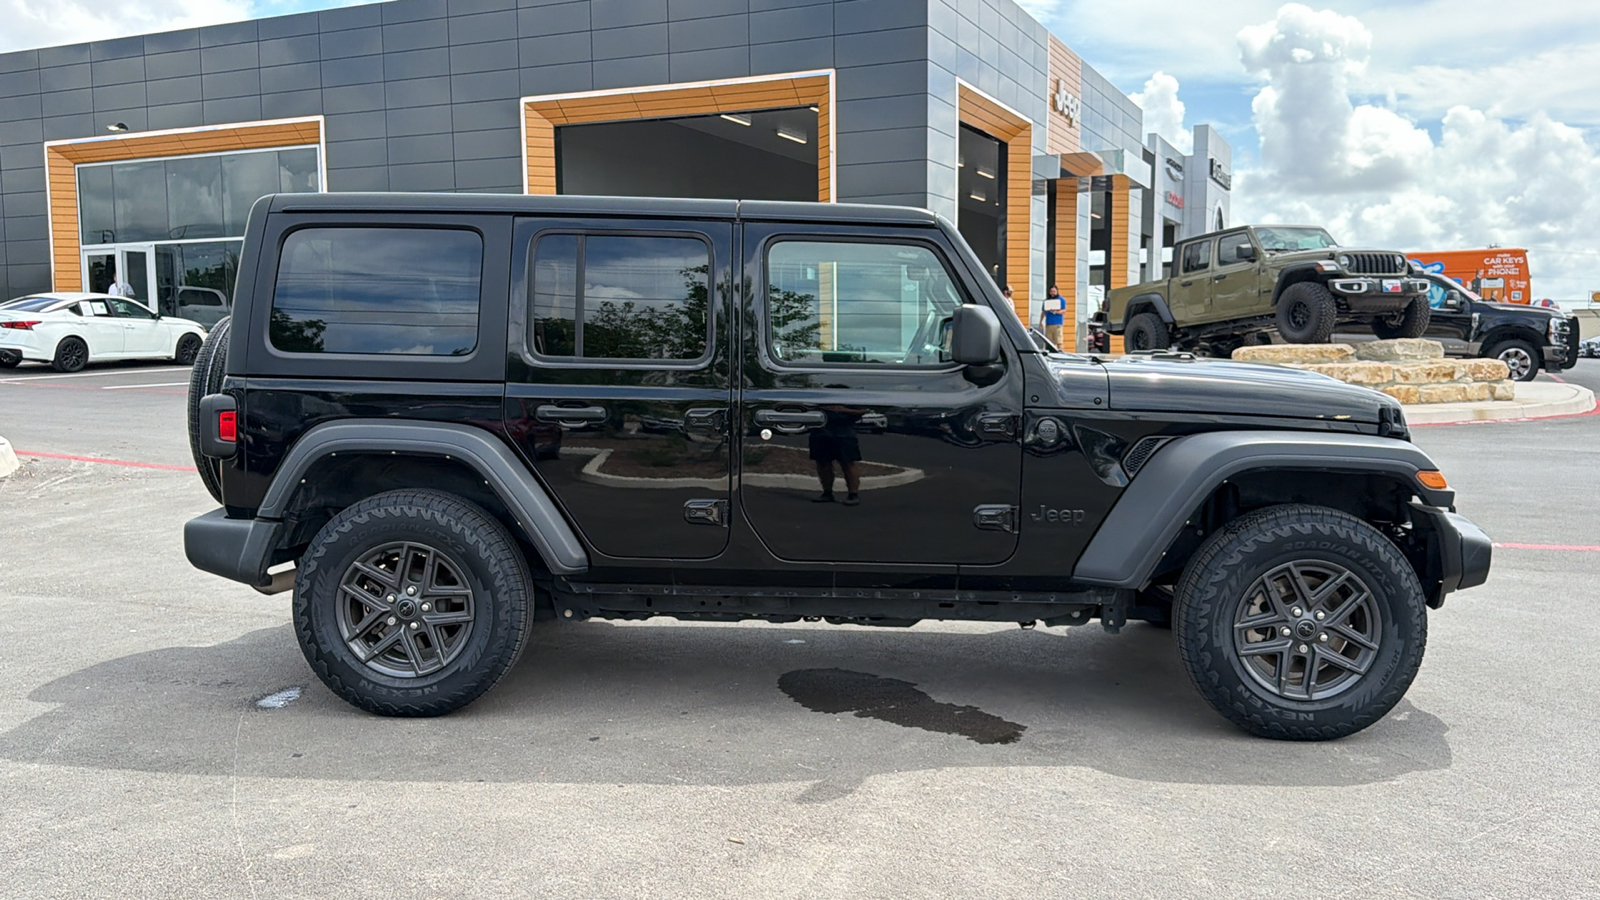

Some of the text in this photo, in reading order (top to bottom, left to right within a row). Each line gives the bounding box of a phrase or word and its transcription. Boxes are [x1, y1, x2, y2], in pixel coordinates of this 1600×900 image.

[1054, 78, 1081, 128] Jeep
[1483, 257, 1502, 265] CAR
[1030, 504, 1085, 528] Jeep
[358, 679, 439, 698] NEXEN
[1236, 684, 1315, 722] NEXEN
